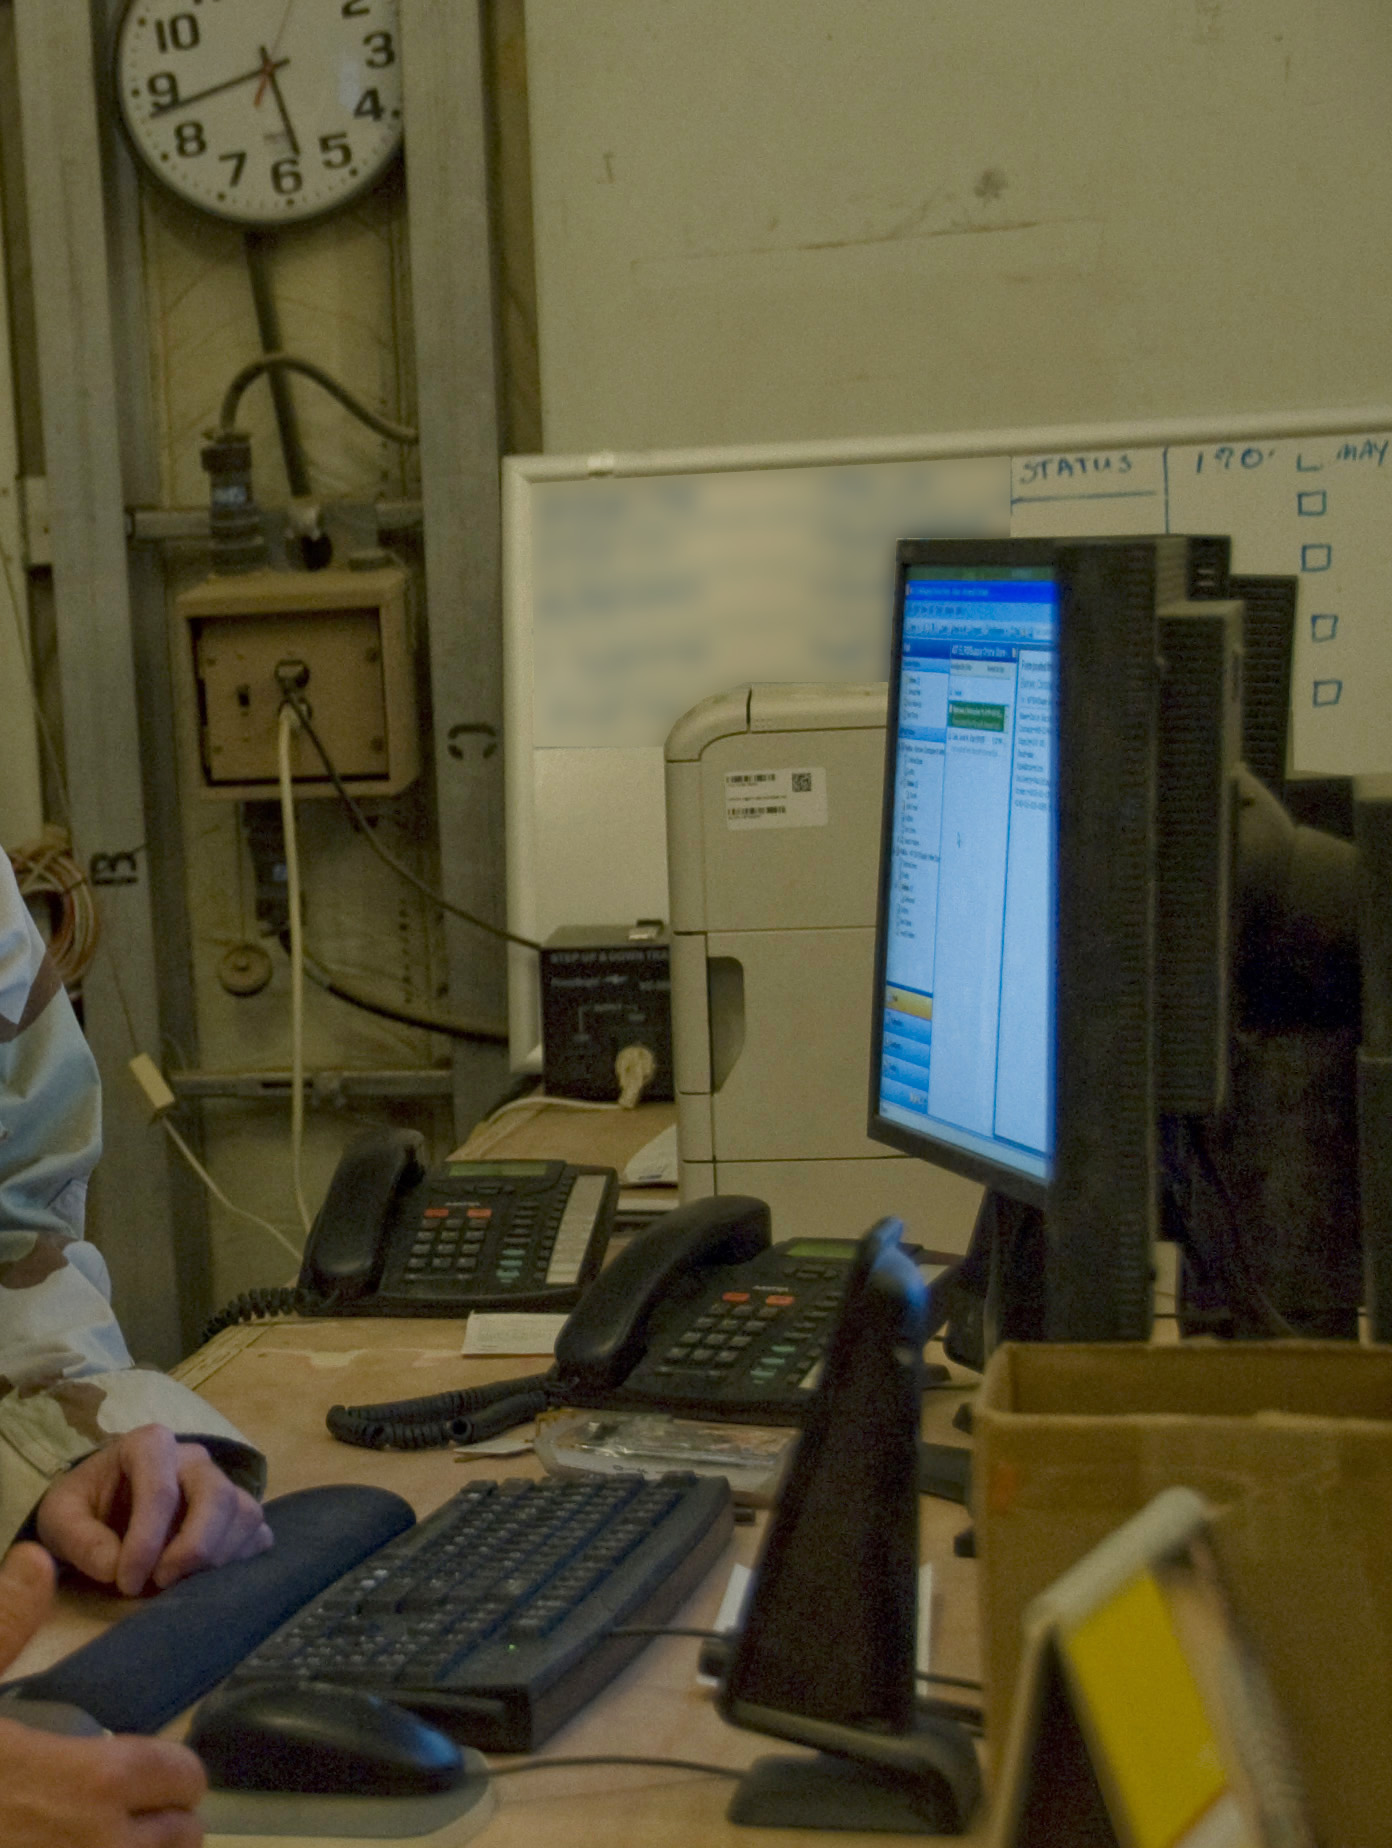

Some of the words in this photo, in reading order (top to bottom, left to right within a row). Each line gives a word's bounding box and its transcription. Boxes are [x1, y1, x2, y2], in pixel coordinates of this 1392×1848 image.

[154, 13, 201, 54] 10
[362, 30, 396, 69] 3
[147, 72, 180, 111] 9
[353, 88, 385, 122] 4
[173, 121, 207, 158] 8
[319, 132, 354, 170] 5
[218, 151, 248, 188] 7
[270, 157, 303, 196] 6
[1019, 454, 1133, 485] STATUS
[1336, 439, 1389, 467] MAY
